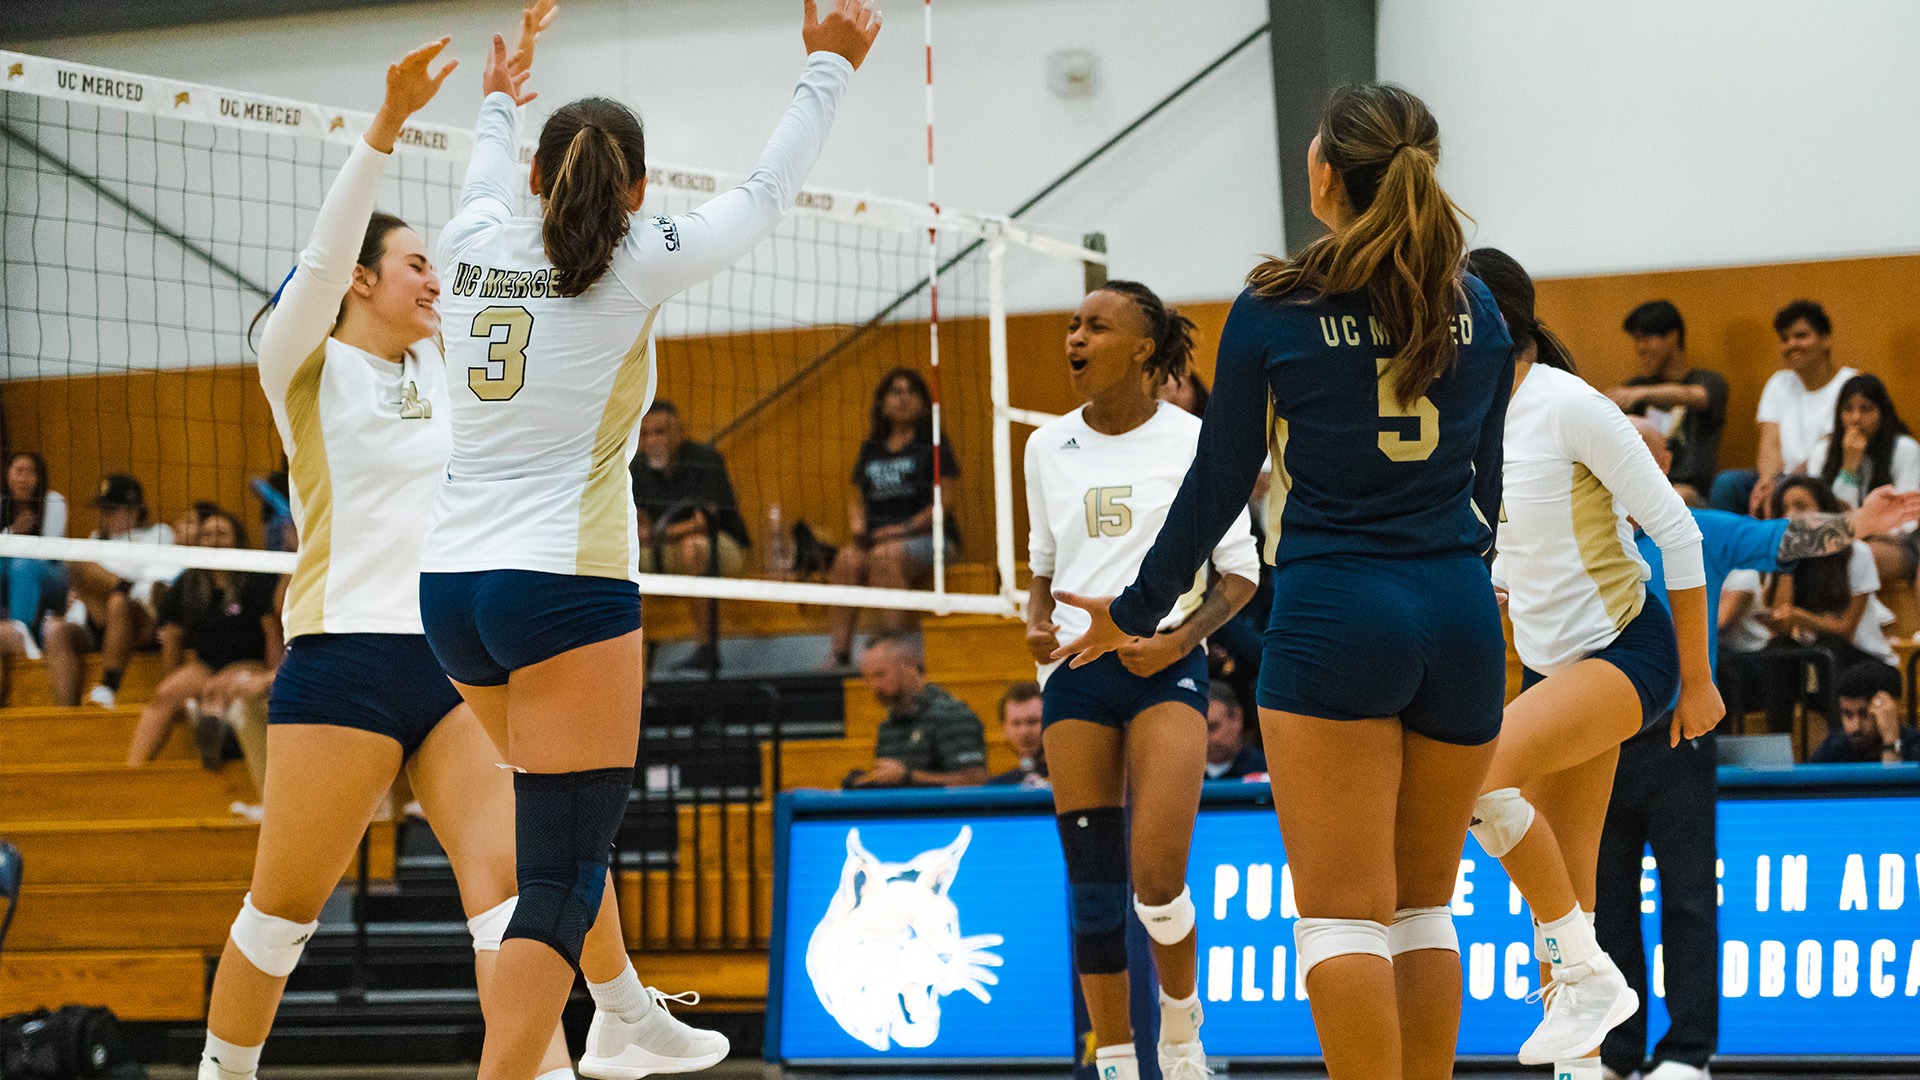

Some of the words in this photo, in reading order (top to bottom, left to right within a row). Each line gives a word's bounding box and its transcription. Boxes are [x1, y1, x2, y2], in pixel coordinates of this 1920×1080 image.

[57, 70, 77, 91] UC
[82, 74, 144, 102] MERCED
[219, 98, 239, 118] UC
[243, 101, 303, 127] MERCED
[452, 262, 482, 297] UC
[479, 267, 578, 298] MERCE
[1319, 314, 1361, 347] UC
[468, 305, 535, 402] 3
[1375, 357, 1440, 462] 5
[1083, 485, 1133, 538] 15
[1756, 854, 1808, 912] IN
[1839, 852, 1920, 911] AD
